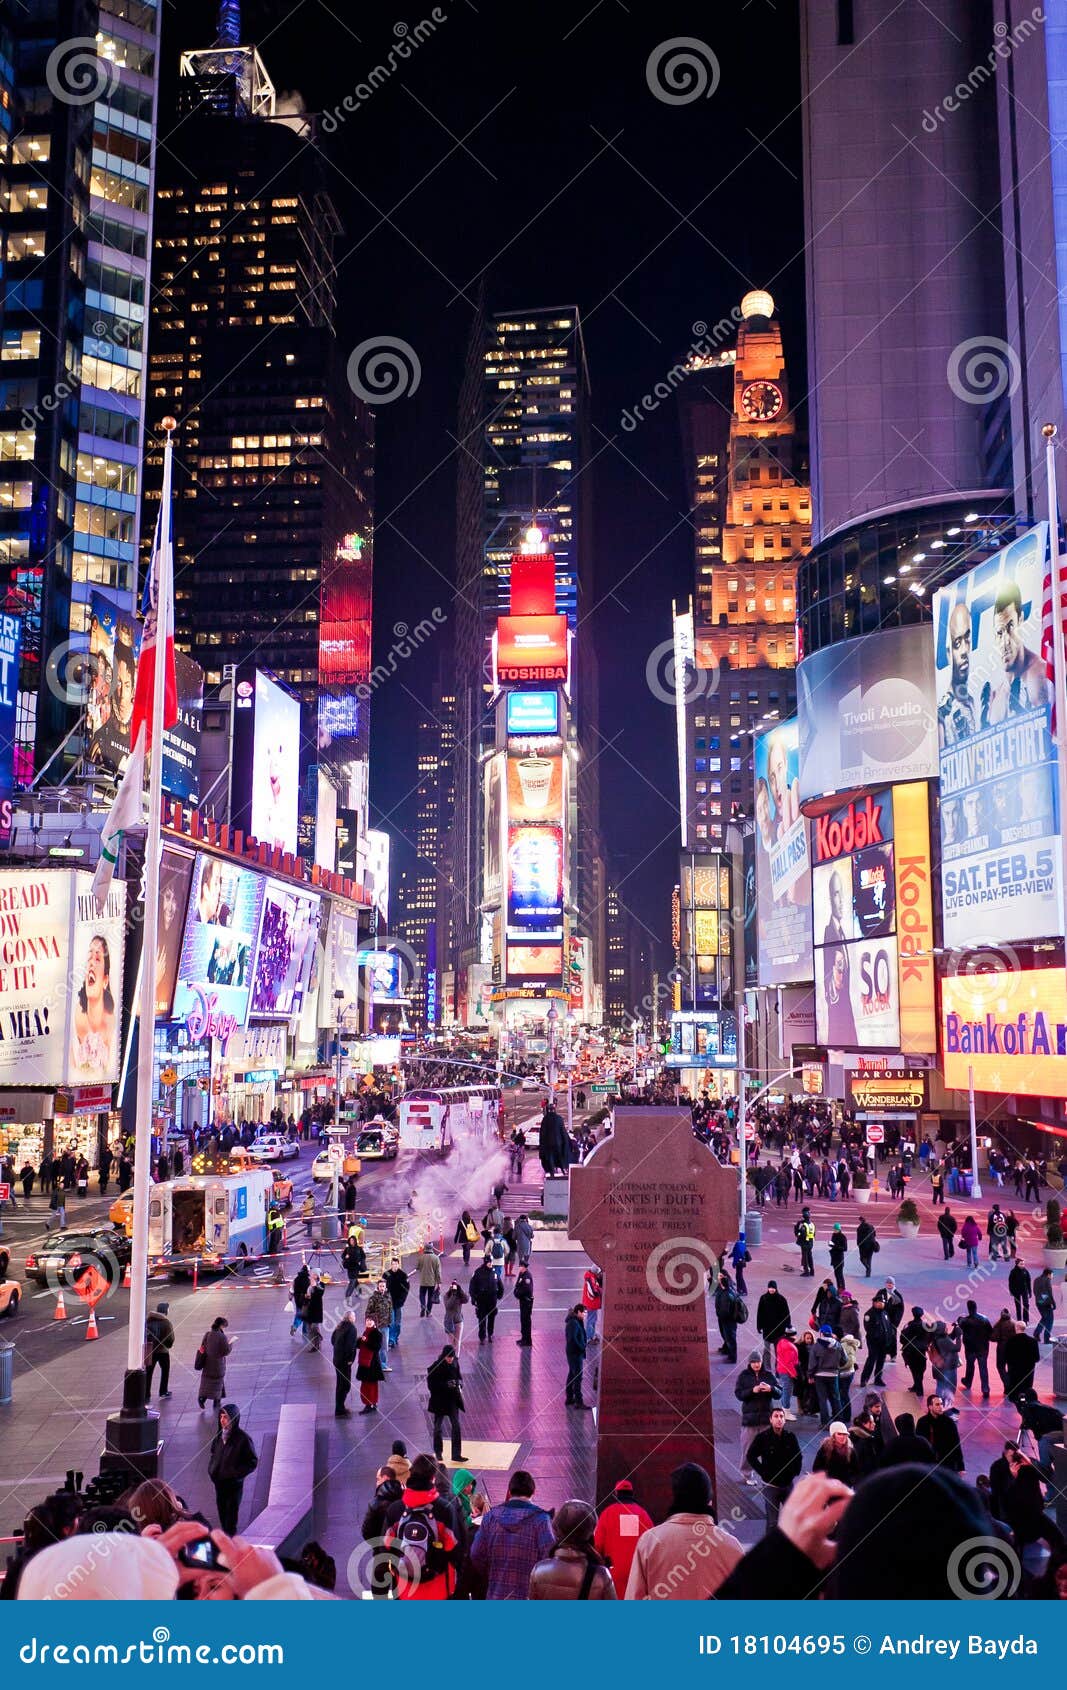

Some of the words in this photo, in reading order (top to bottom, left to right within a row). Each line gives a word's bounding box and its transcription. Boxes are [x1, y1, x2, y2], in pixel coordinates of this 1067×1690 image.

[511, 553, 555, 562] TOSHIBA
[499, 667, 566, 681] TOSHIBA
[843, 708, 875, 727] Tivoli
[879, 701, 922, 720] Audio
[940, 745, 971, 795] SILVA
[984, 715, 1048, 779] BELFORT
[864, 762, 932, 780] Anniversary
[816, 795, 883, 862] Kodak
[945, 864, 982, 897] SAT.
[985, 854, 1034, 888] FEB.
[1036, 849, 1054, 878] 5
[945, 895, 964, 911] LIVE
[965, 892, 979, 907] ON
[980, 877, 1054, 903] PAY-PER-VIEW
[898, 855, 929, 983] Kodak
[2, 936, 61, 965] GONNA
[13, 964, 37, 991] IT!
[860, 949, 891, 997] SO
[9, 1007, 50, 1039] MIA!
[946, 1011, 1000, 1054] Bank
[1003, 1011, 1028, 1054] of
[851, 1070, 926, 1079] MARQUIS
[854, 1093, 924, 1107] WONDERLAND
[603, 1194, 651, 1205] FRANCIS
[665, 1194, 705, 1205] DUFFY
[616, 1221, 657, 1230] CATHOLIC
[662, 1221, 692, 1230] PRIEST
